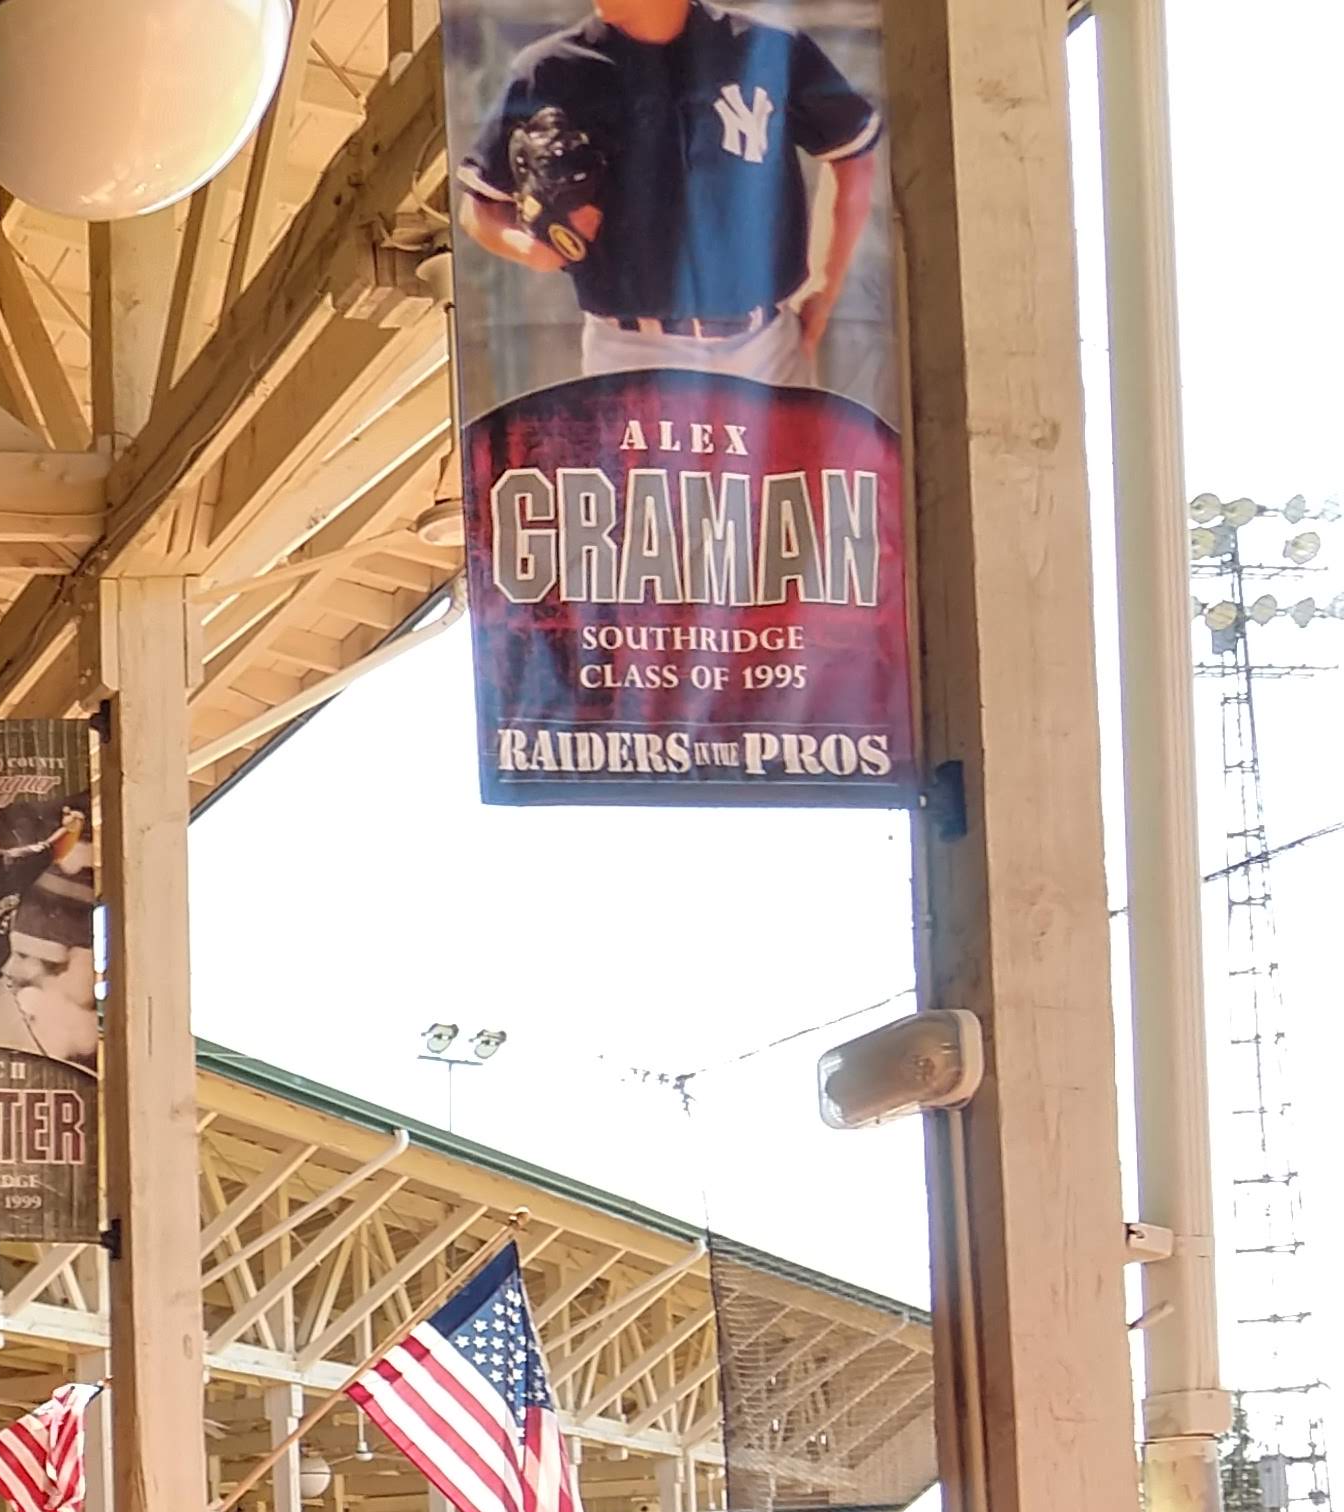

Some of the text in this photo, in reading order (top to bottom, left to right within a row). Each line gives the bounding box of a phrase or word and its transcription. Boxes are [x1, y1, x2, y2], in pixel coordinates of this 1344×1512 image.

[620, 420, 749, 455] ALEX
[490, 467, 880, 607] GRAMAN
[582, 626, 806, 654] SOUTHRIDGE
[580, 664, 807, 691] CLASS OF 1995
[8, 757, 66, 769] COUNTY
[498, 729, 691, 774] RAIDERS
[742, 732, 892, 776] PROS
[5, 1195, 42, 1209] 1999
